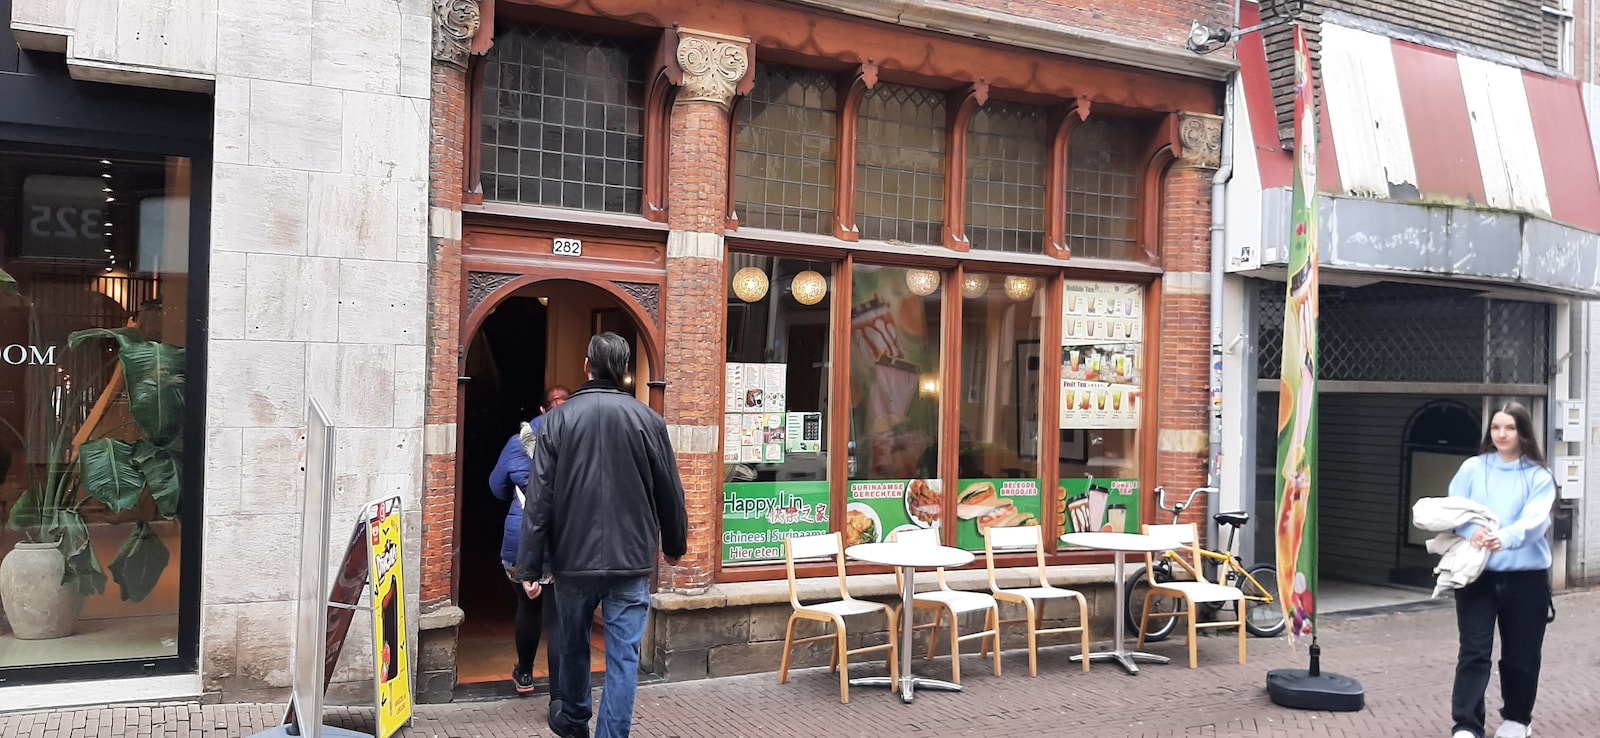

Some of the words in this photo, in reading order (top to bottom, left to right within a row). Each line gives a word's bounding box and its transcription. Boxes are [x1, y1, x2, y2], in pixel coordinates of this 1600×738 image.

[554, 240, 580, 254] 282
[0, 343, 57, 366] OM
[852, 483, 904, 492] SURINAAMSE
[853, 490, 902, 498] GERECHTEN
[722, 492, 776, 518] Happy
[780, 491, 803, 510] Lin
[723, 530, 766, 543] Chinees
[730, 546, 753, 558] Hier
[754, 547, 778, 557] eten
